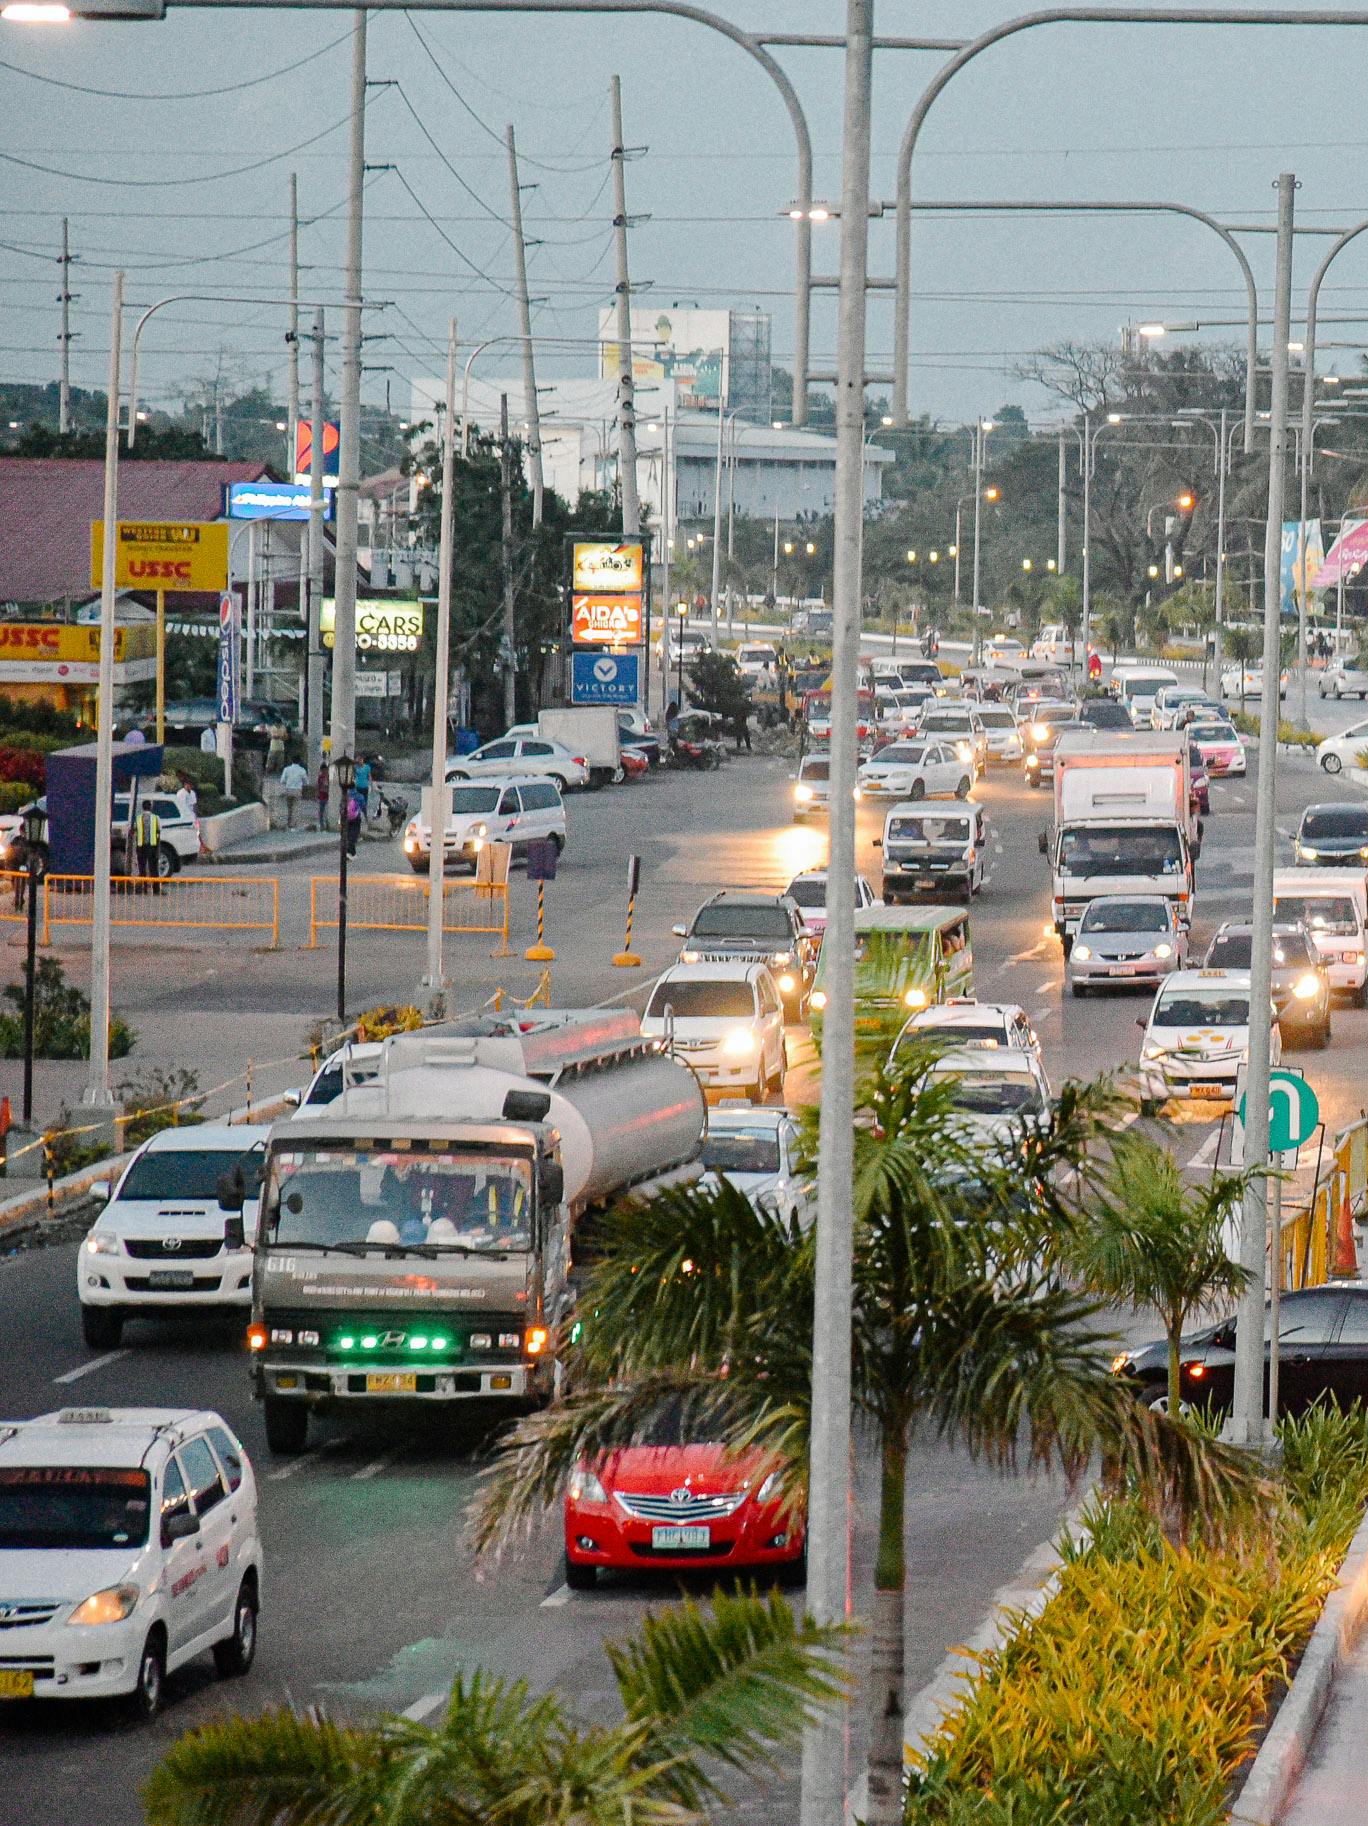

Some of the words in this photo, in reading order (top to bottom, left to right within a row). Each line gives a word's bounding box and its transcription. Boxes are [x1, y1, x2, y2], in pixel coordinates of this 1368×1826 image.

[128, 560, 192, 579] USSC
[359, 612, 421, 636] CARS
[221, 641, 231, 722] pepsi
[576, 683, 635, 692] VICTORY
